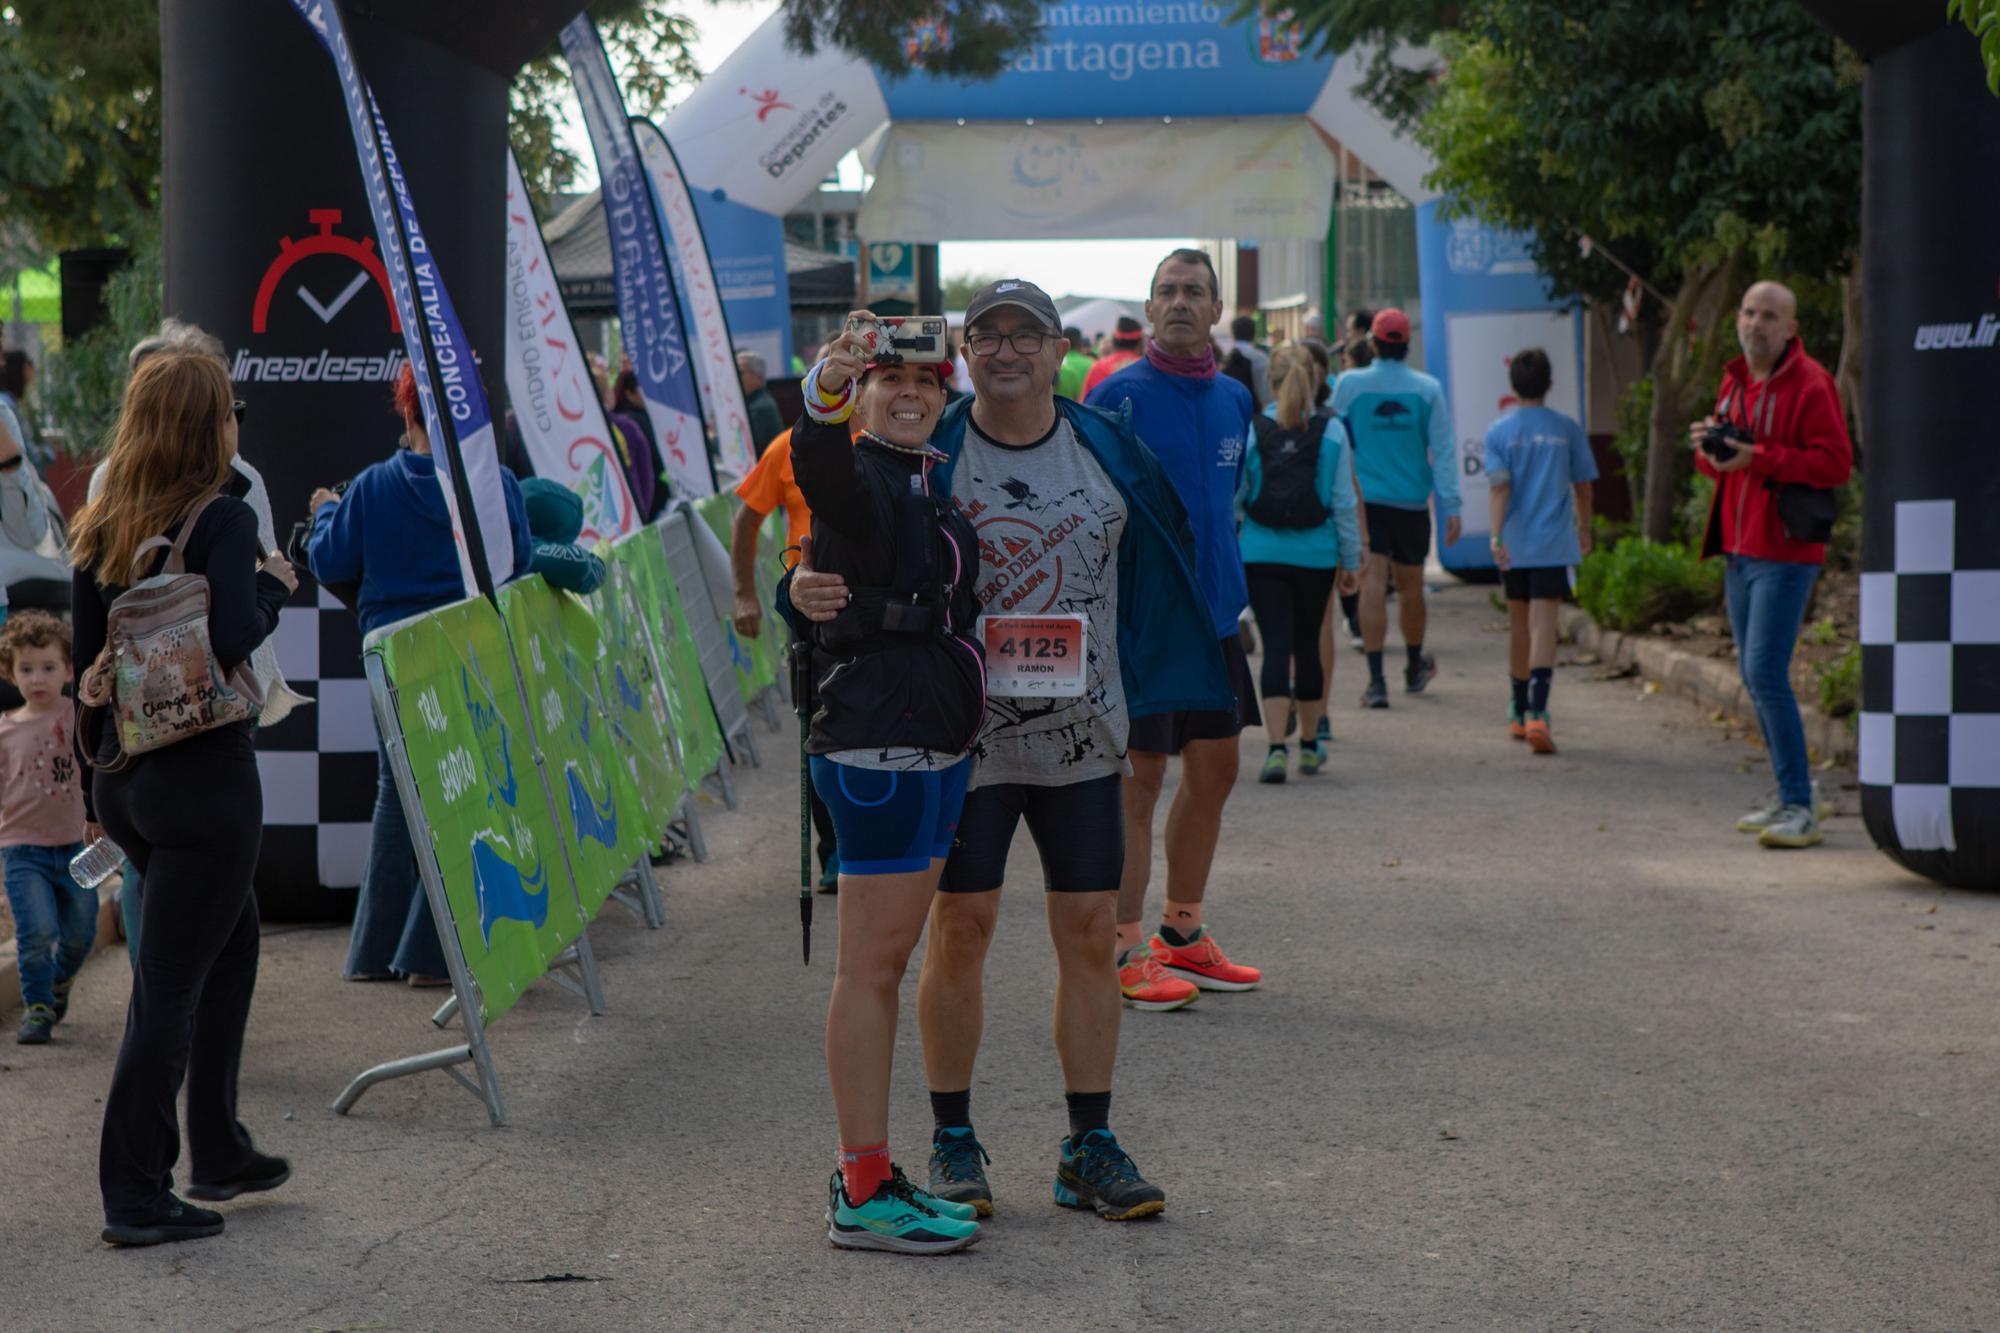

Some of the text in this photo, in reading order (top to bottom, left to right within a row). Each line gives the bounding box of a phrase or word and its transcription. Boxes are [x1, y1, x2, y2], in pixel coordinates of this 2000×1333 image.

[1002, 39, 1222, 80] artagena
[767, 101, 848, 178] Deportes
[414, 262, 471, 421] CONCEJALIA
[1006, 547, 1043, 579] DEL
[1040, 513, 1087, 553] AGUA
[999, 637, 1068, 658] 4125
[195, 684, 217, 702] the
[171, 701, 217, 731] world
